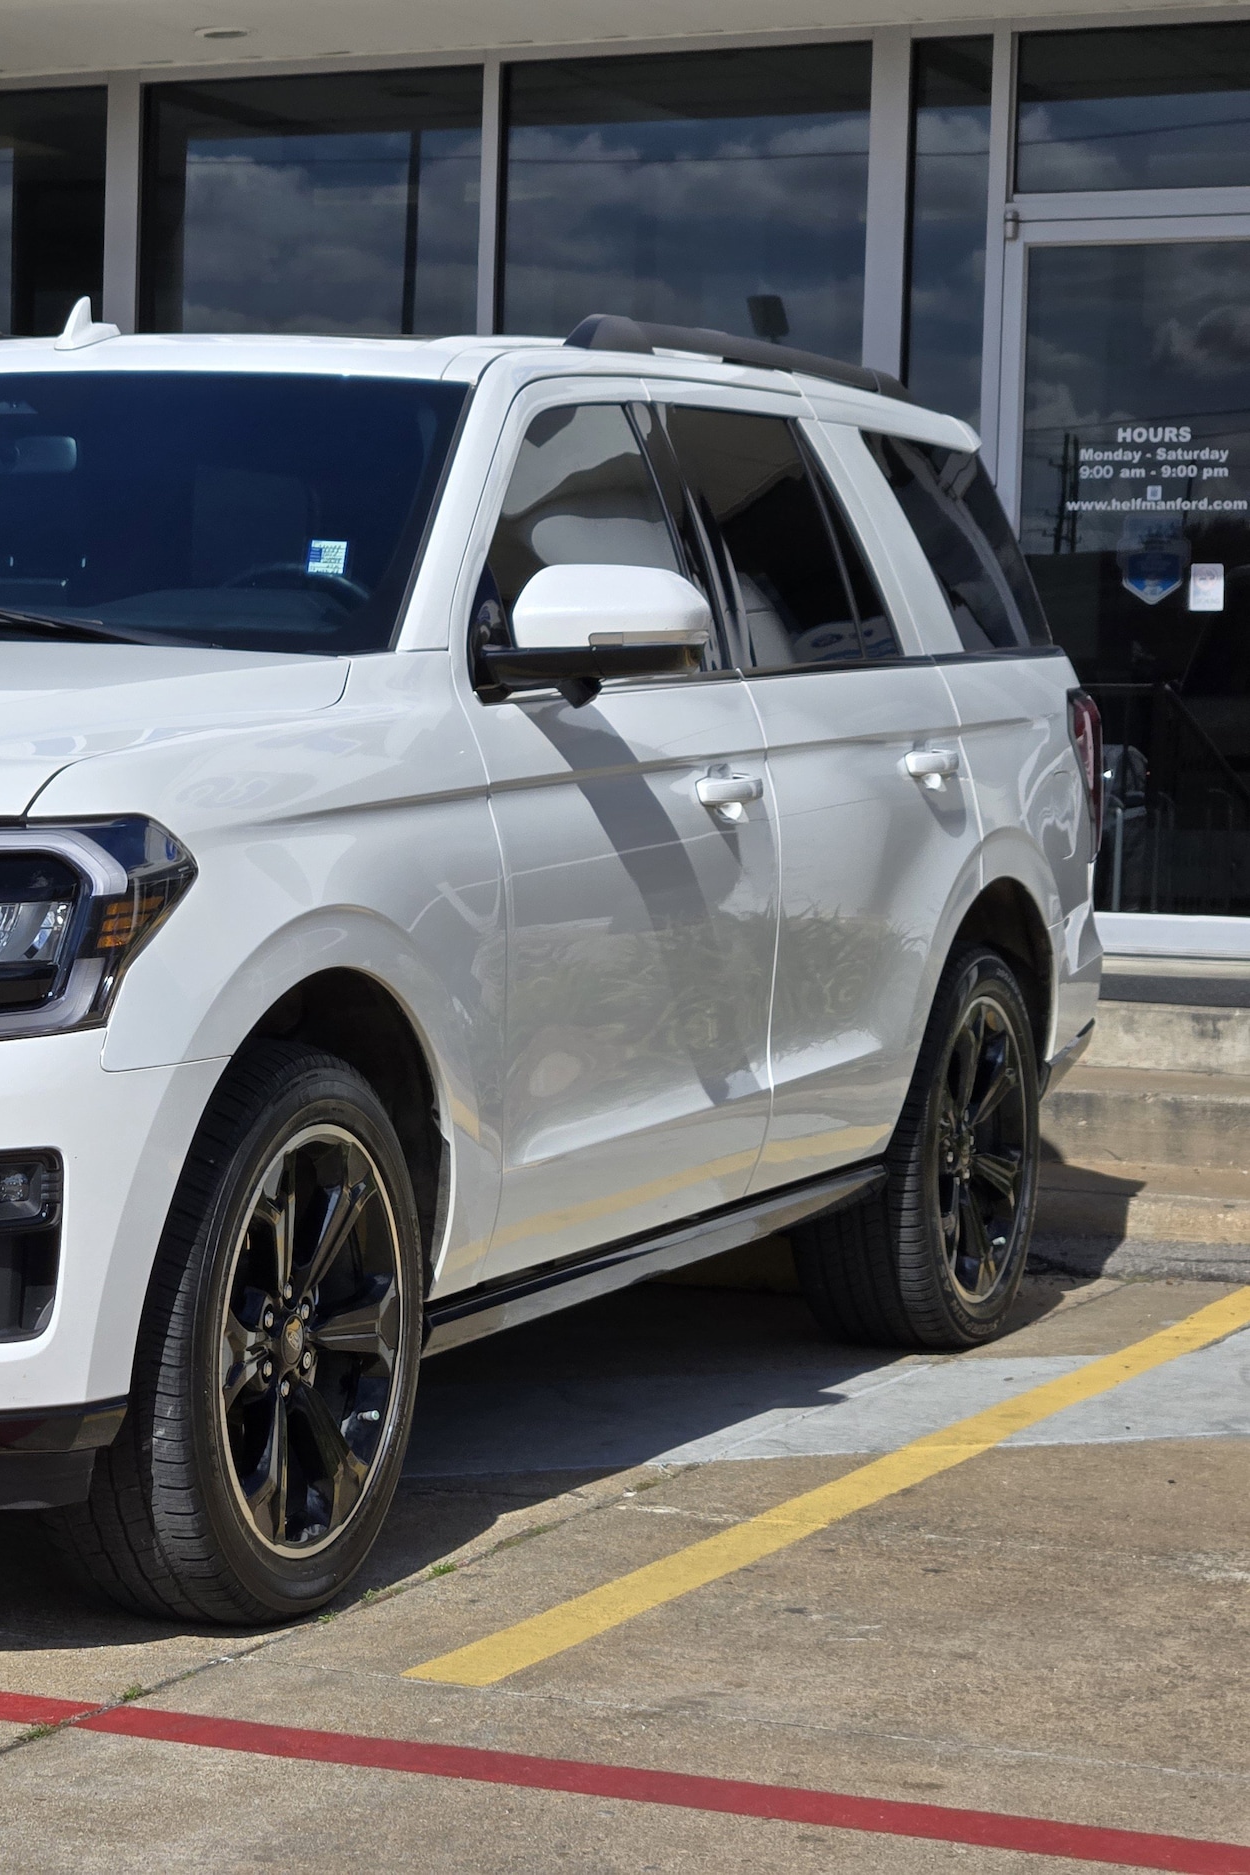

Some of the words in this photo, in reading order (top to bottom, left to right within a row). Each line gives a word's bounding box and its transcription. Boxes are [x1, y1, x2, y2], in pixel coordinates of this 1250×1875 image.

[1117, 426, 1192, 443] HOURS
[1080, 448, 1142, 463] Monday
[1156, 447, 1229, 462] Saturday
[1079, 465, 1114, 479] 9:00
[1119, 467, 1146, 478] am
[1161, 465, 1198, 478] 9:00
[1202, 466, 1229, 480] pm
[1066, 498, 1248, 511] www.helfmanford.com
